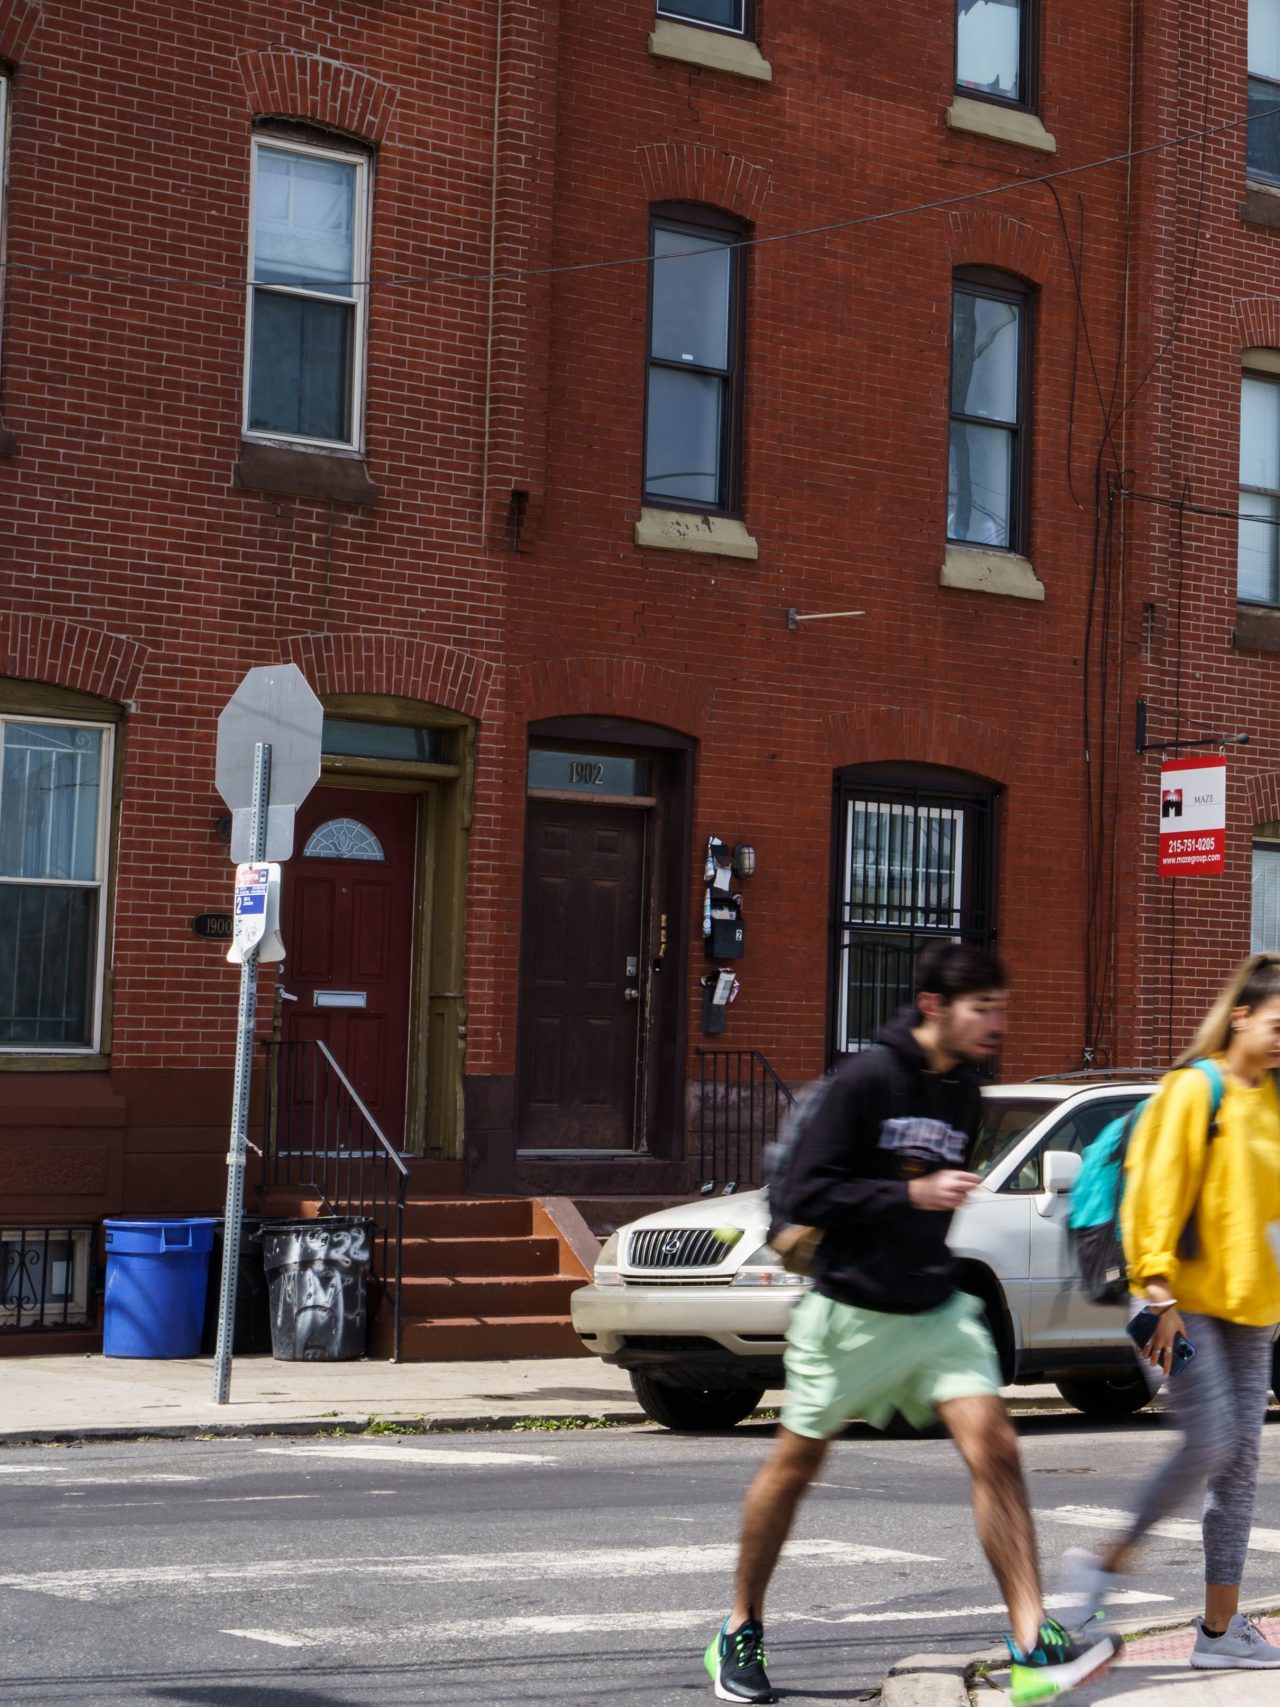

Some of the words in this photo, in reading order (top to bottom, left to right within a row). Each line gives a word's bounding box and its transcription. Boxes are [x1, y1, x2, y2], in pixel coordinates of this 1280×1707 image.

[568, 760, 604, 785] 1902
[1194, 794, 1214, 804] MAZE
[1168, 838, 1215, 853] 215-751-0205
[1162, 854, 1221, 865] www.mazegroup.com
[236, 896, 242, 914] 2
